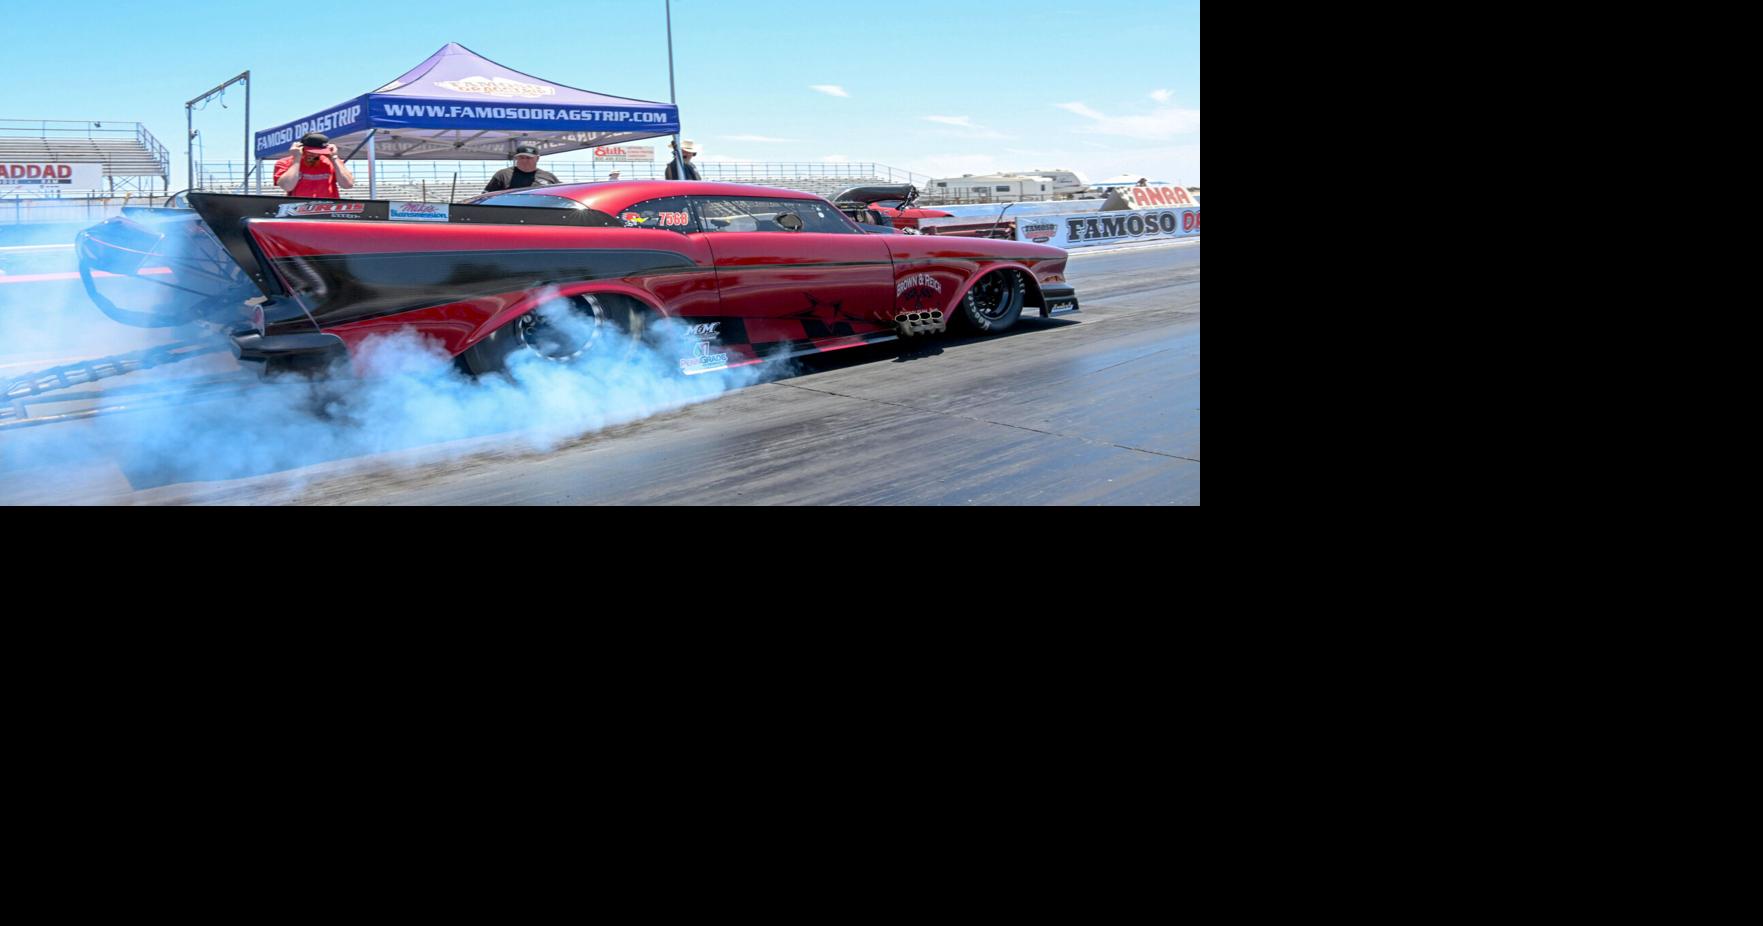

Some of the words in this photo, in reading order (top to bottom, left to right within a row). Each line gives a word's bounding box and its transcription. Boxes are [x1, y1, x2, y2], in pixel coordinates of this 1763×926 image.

[384, 104, 667, 123] WWW.FAMOSODRAGSTRIP.COM
[257, 127, 293, 151] FAMOSO
[294, 105, 361, 139] DRAGSTRIP
[1132, 187, 1191, 206] ANRA
[658, 211, 689, 226] 7568
[1068, 211, 1176, 243] FAMOSO
[896, 275, 918, 297] BROWN
[918, 273, 924, 286] &
[924, 274, 941, 294] REICH
